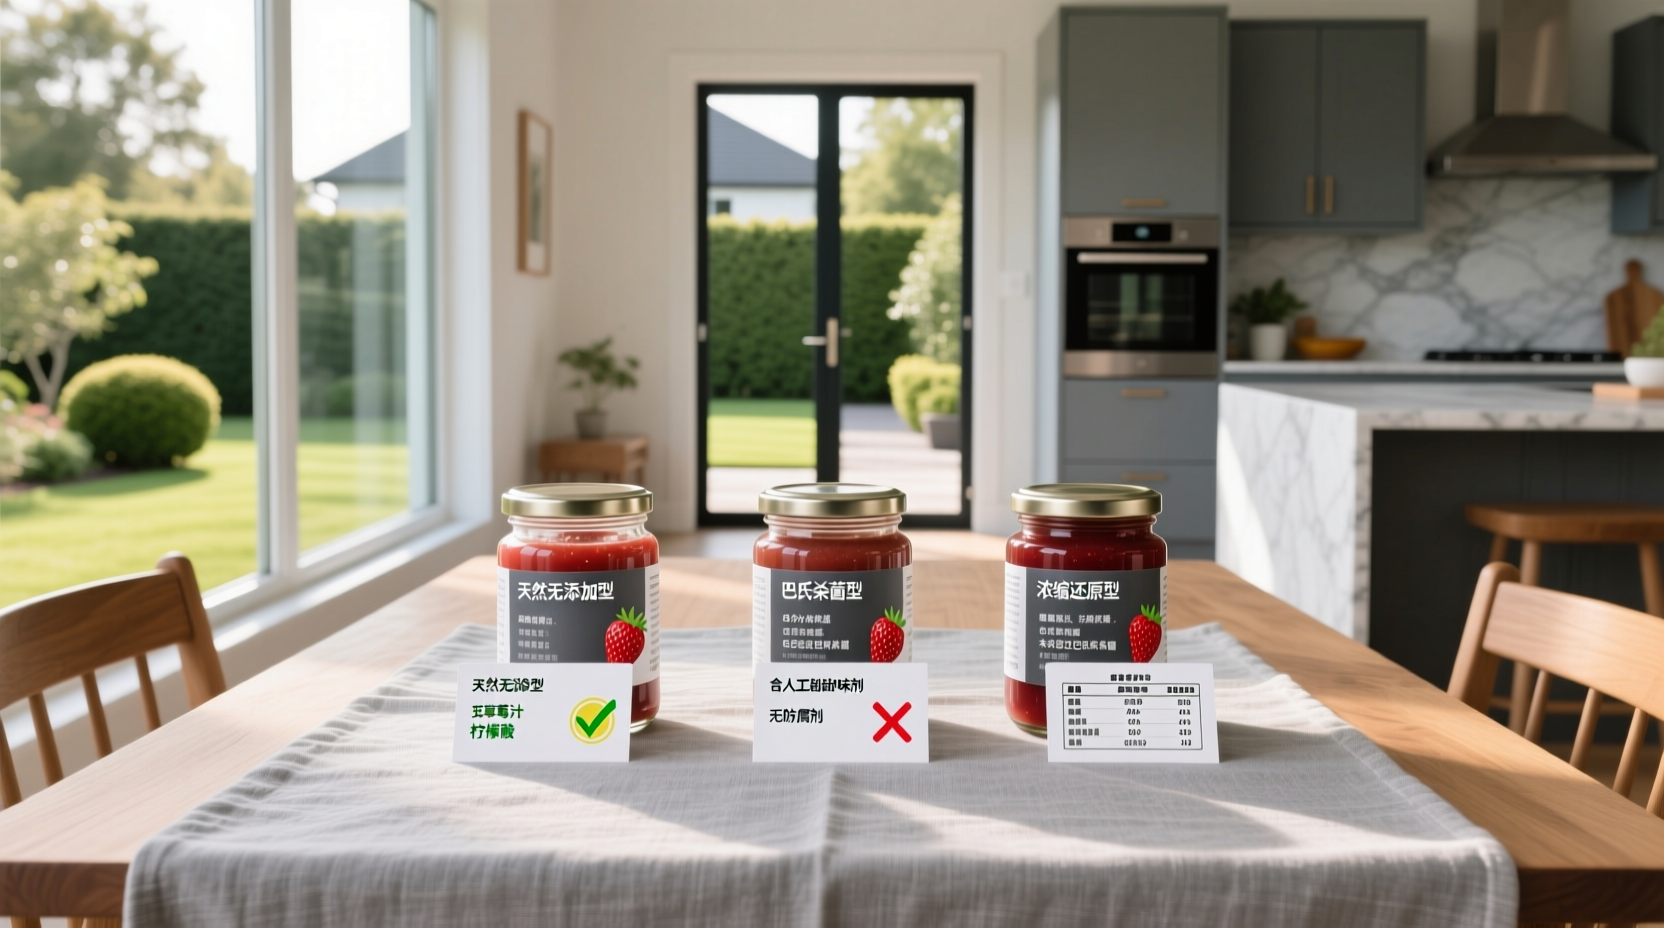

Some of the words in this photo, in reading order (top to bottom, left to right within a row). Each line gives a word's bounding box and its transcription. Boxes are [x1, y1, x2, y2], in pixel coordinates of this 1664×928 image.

[517, 581, 615, 601] 天然无添加型
[1036, 579, 1120, 601] 浓缩还原型
